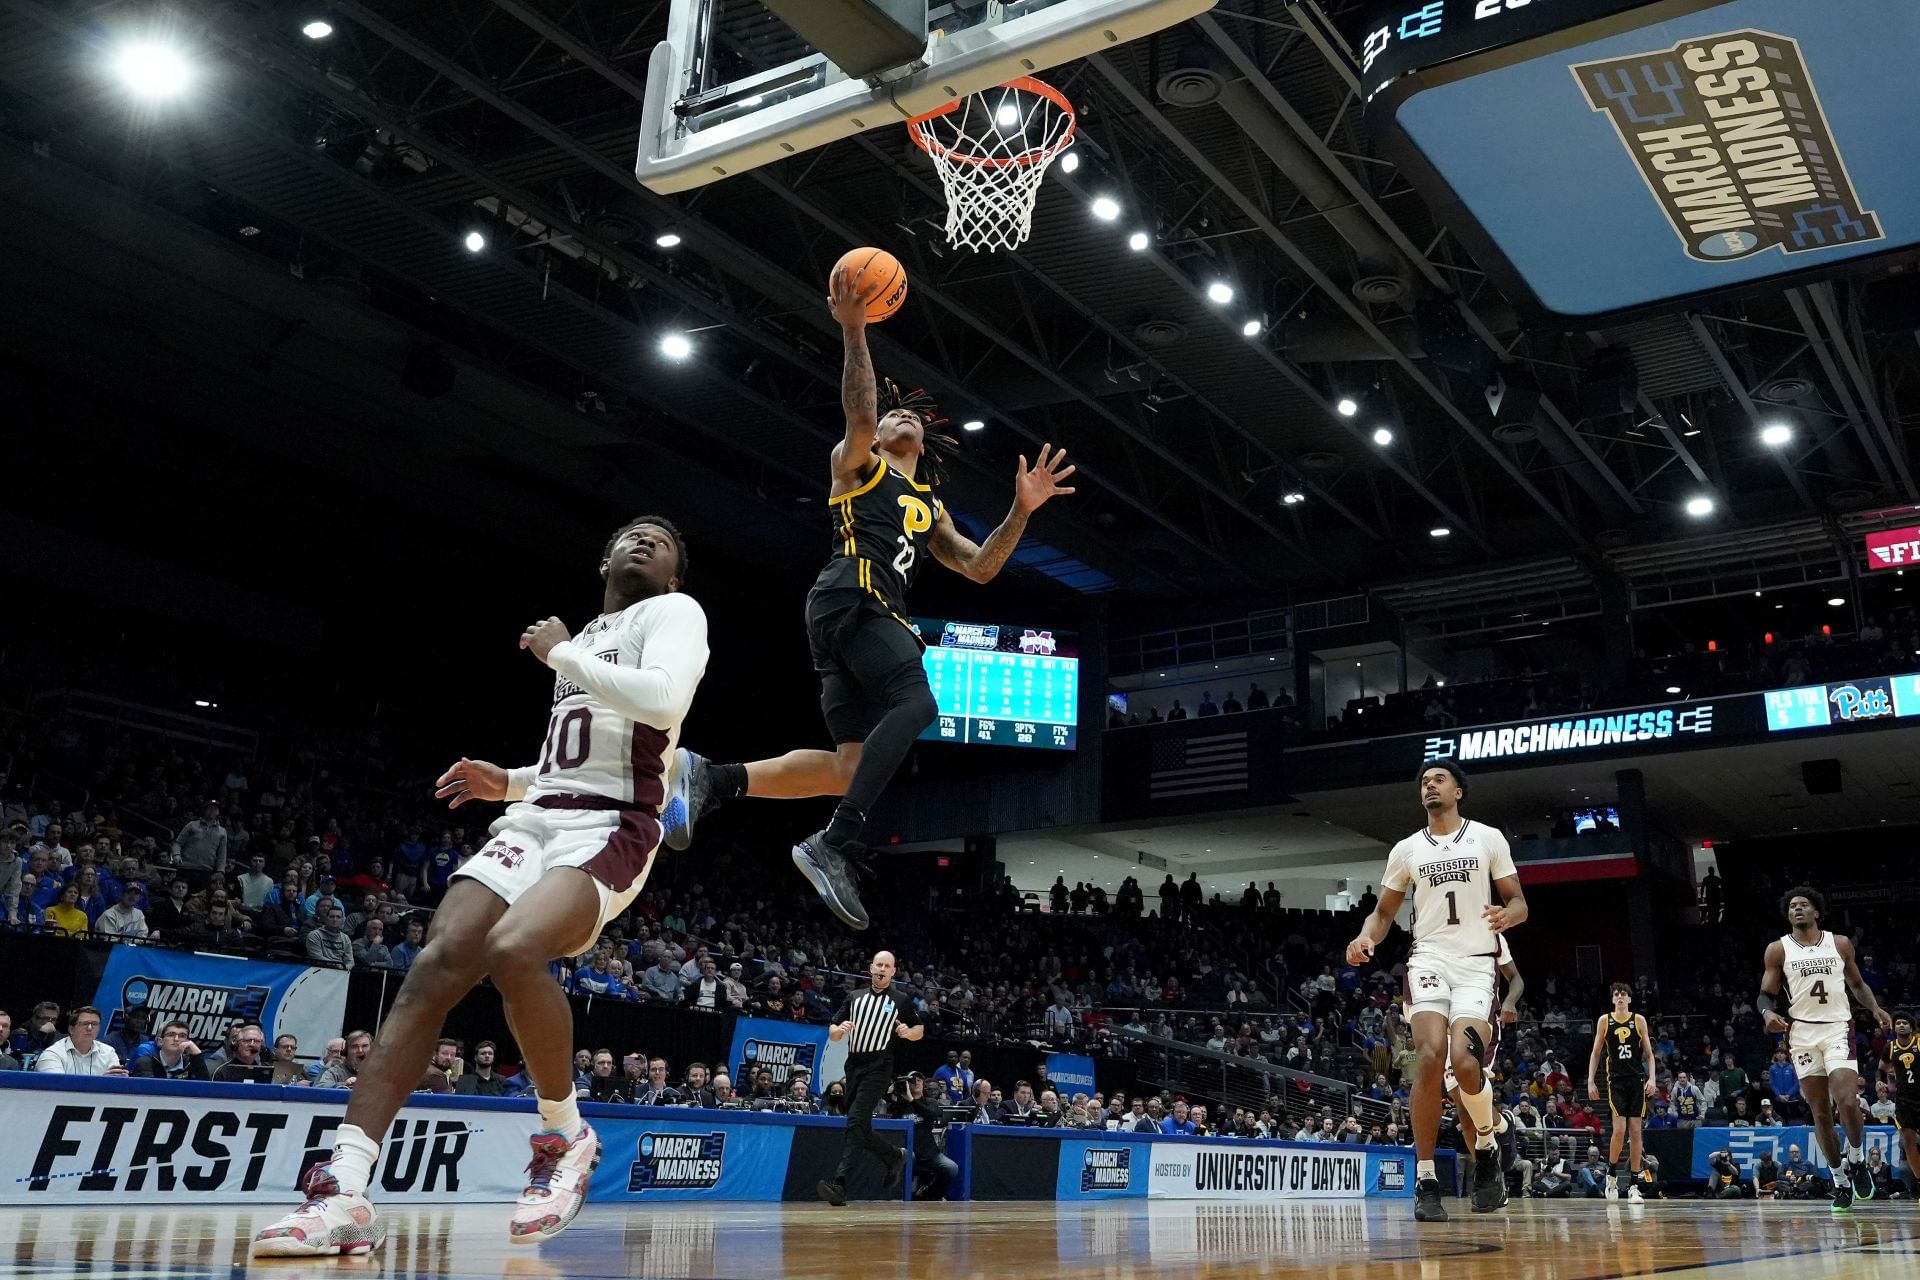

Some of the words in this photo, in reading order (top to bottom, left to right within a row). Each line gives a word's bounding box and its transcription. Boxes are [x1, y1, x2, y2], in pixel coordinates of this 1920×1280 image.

[1682, 39, 1820, 208] MADNESS
[1637, 124, 1755, 233] MARCH
[955, 626, 984, 636] MARCH
[1830, 686, 1891, 719] Pitt
[1418, 858, 1479, 877] MISSISSIPPI
[1435, 872, 1464, 885] STATE
[1445, 891, 1460, 925] 1
[1792, 958, 1837, 970] MISSISSIPPI
[147, 984, 229, 1014] MARCH
[1810, 980, 1828, 1004] 4
[1614, 1027, 1631, 1043] P
[756, 1043, 797, 1064] MARCH
[1617, 1044, 1632, 1059] 25
[28, 1105, 290, 1192] FIRST
[294, 1115, 470, 1192] FUR
[653, 1137, 702, 1158] MARCH
[656, 1159, 720, 1180] MADNESS
[1092, 1151, 1118, 1167] MARCH
[1095, 1168, 1129, 1183] MADNESS
[1155, 1163, 1180, 1177] HOSTED
[1182, 1164, 1191, 1177] BY
[1195, 1152, 1287, 1191] UNIVERSITY
[1290, 1155, 1308, 1191] OF
[1311, 1156, 1361, 1191] DAYTON
